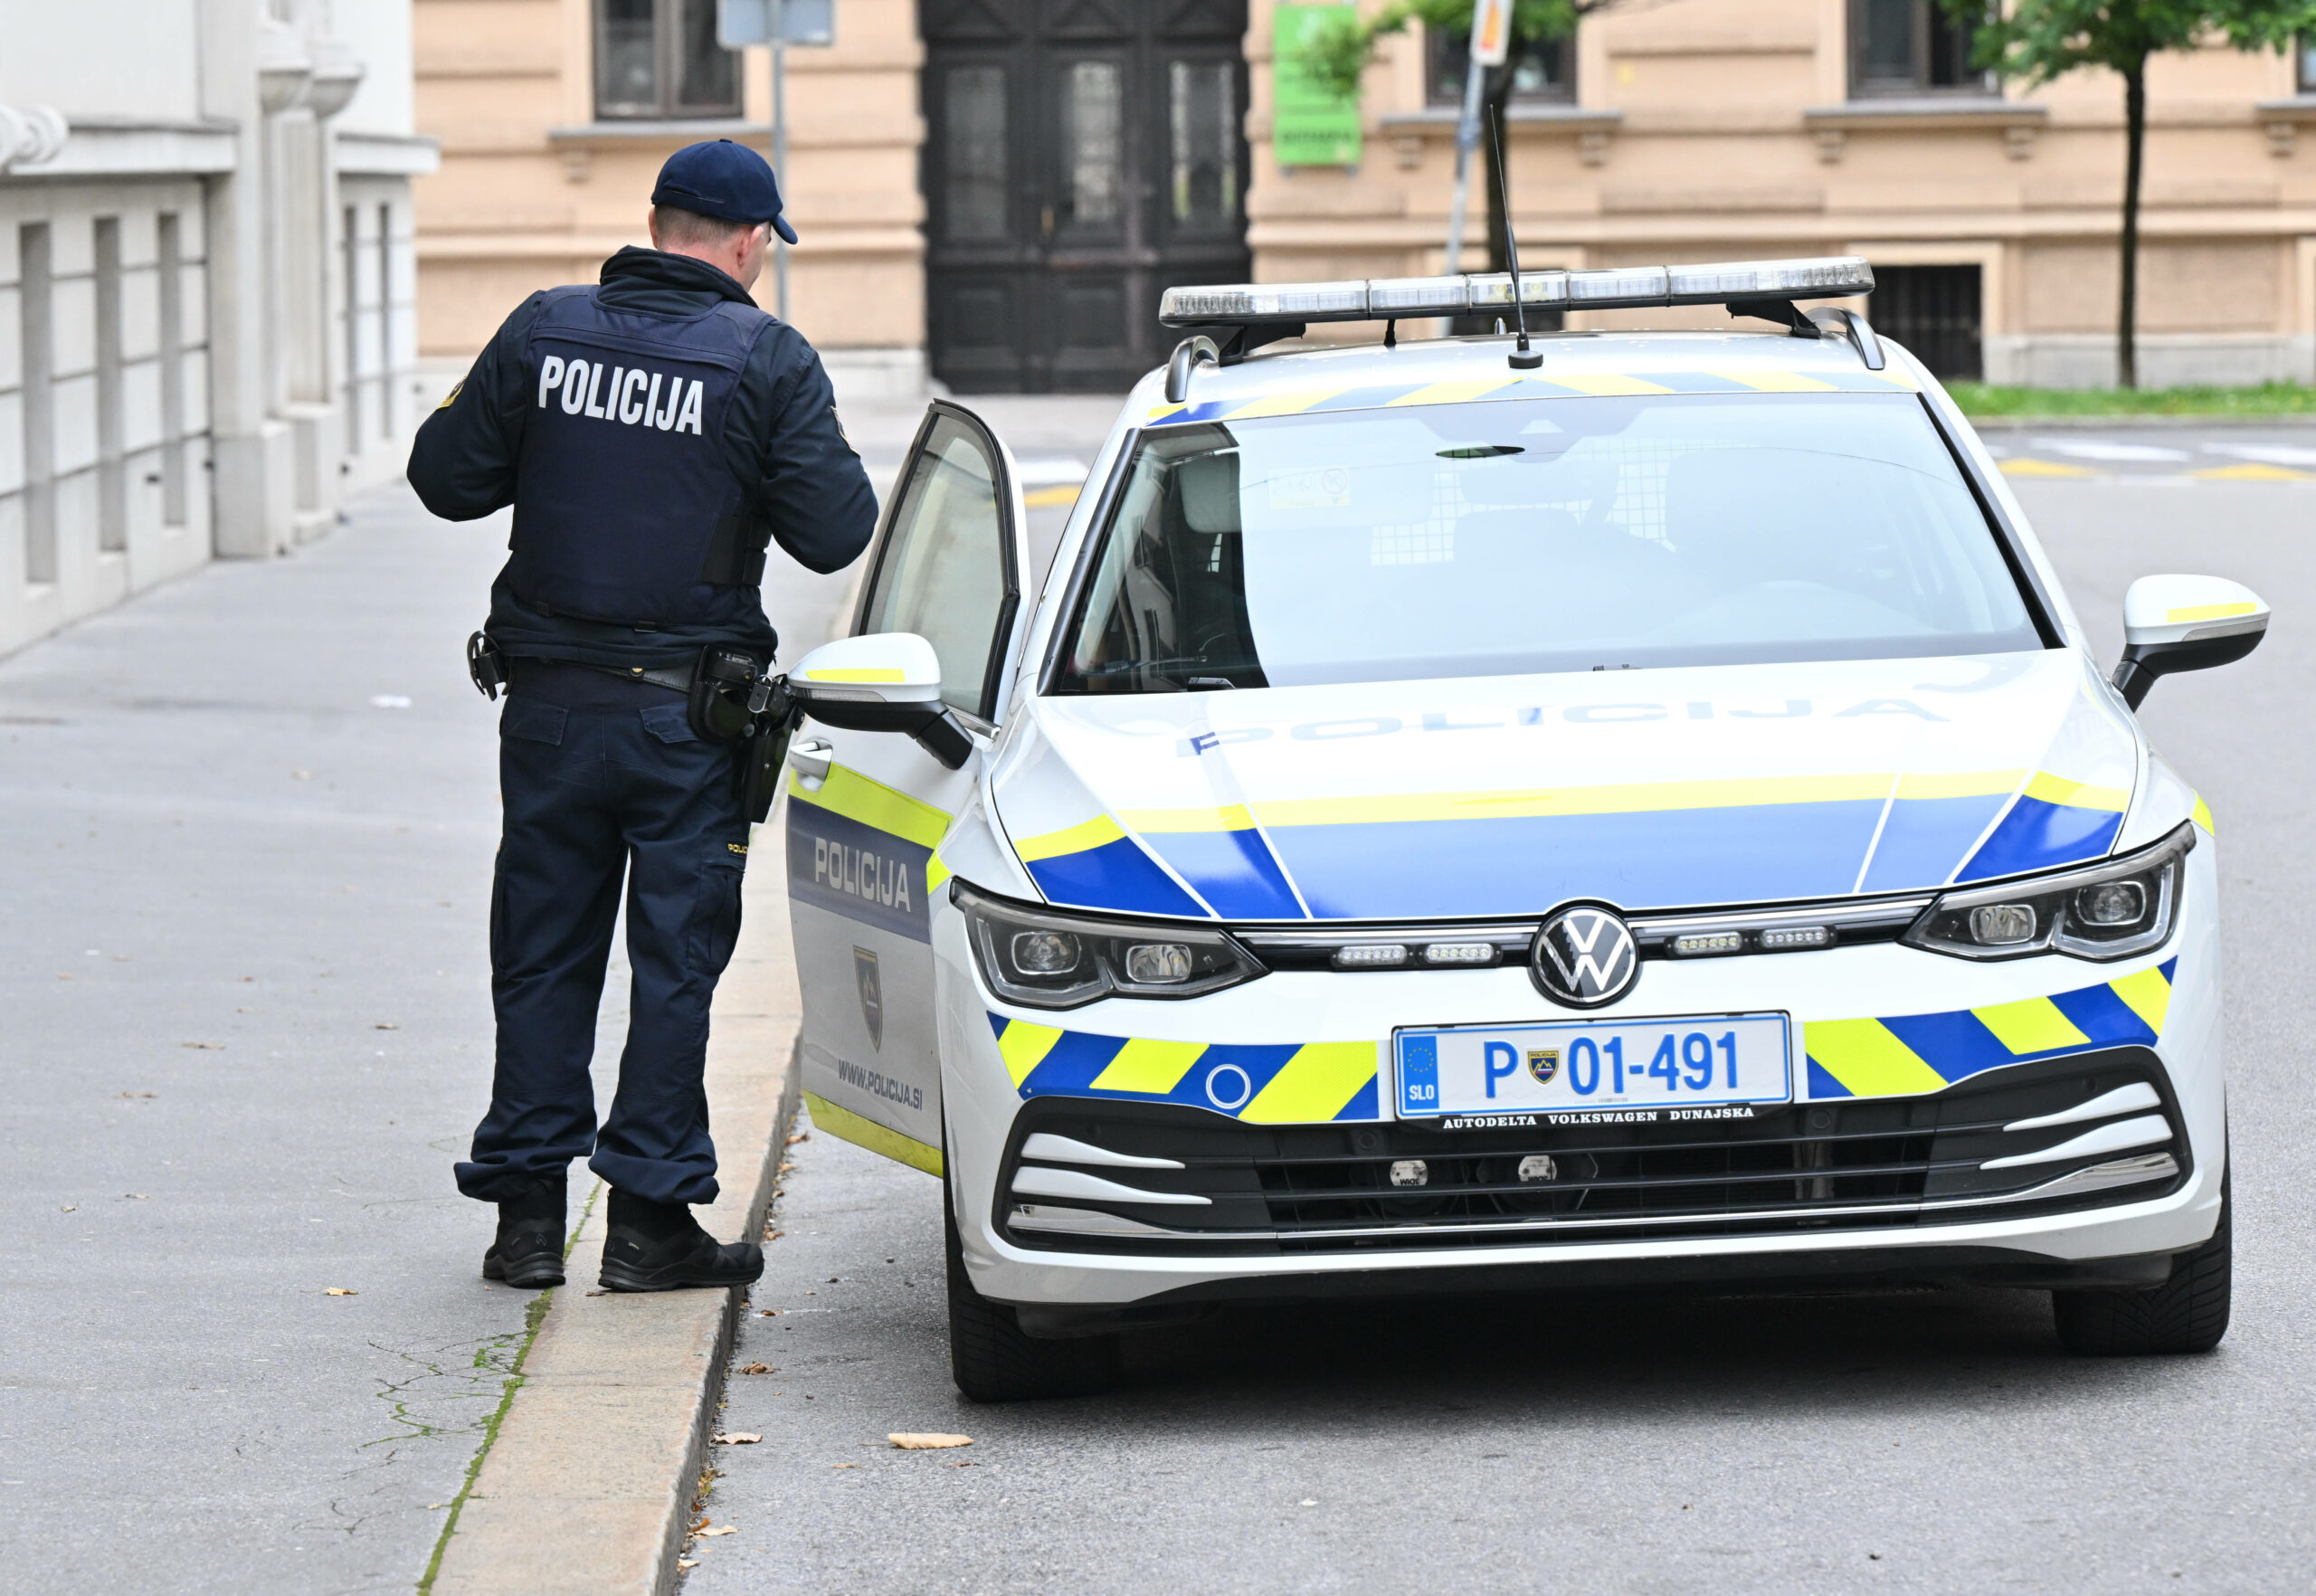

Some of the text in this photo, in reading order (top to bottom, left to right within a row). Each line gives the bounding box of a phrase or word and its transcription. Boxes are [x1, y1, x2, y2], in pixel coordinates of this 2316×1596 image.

[538, 355, 704, 435] POLICIJA
[1175, 698, 1952, 758] POLICIJA
[815, 837, 911, 913] POLICIJA
[839, 1059, 923, 1110] WWW.POLICIJA.SI
[1409, 1084, 1435, 1101] SLO
[1484, 1031, 1738, 1099] P 01-491
[1442, 1107, 1754, 1129] AUTODELTA VOLKSWAGEN DUNAJSKA
